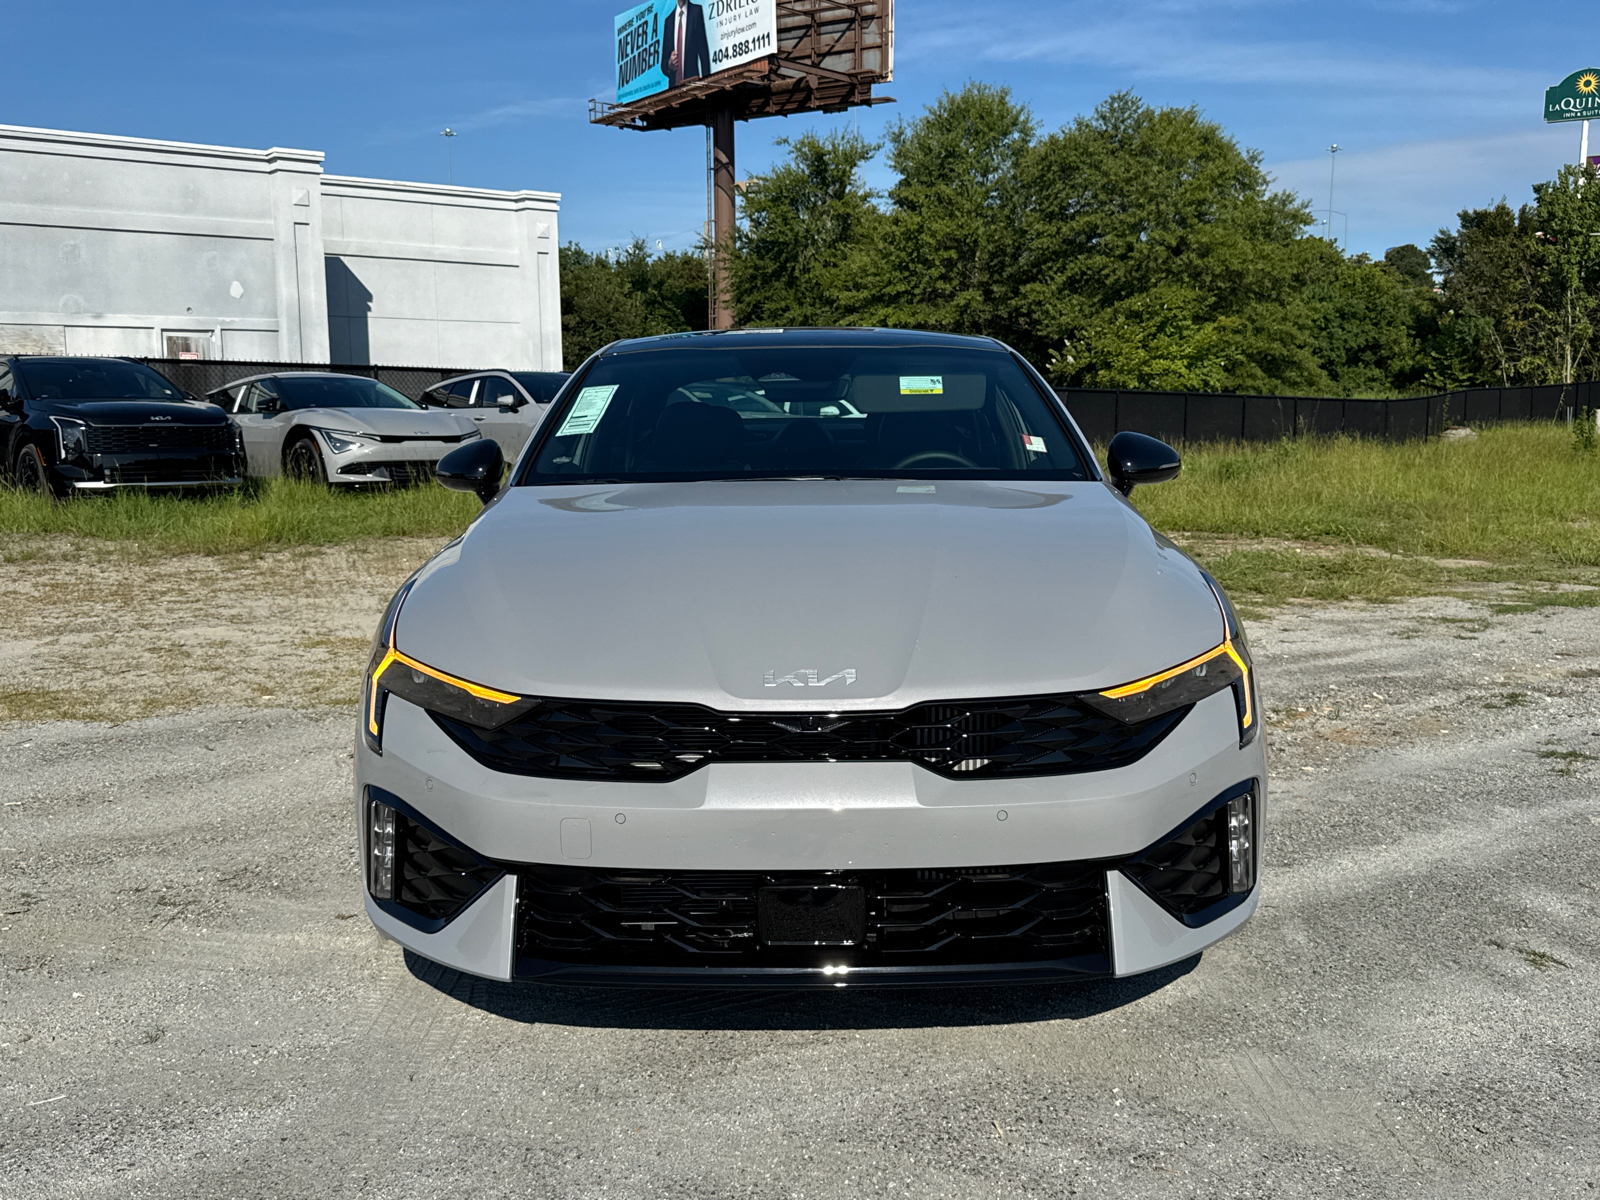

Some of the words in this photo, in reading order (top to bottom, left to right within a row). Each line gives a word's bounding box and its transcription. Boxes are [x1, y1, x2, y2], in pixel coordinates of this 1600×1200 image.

[716, 13, 742, 28] INJURY
[745, 6, 760, 18] LAW
[617, 19, 649, 65] NEVER
[650, 12, 658, 41] A
[720, 22, 757, 41] zinjurylaw.com
[712, 31, 771, 65] 404.888.1111
[617, 38, 660, 90] NUMBER
[1549, 104, 1560, 112] LA
[763, 668, 857, 687] KIA
